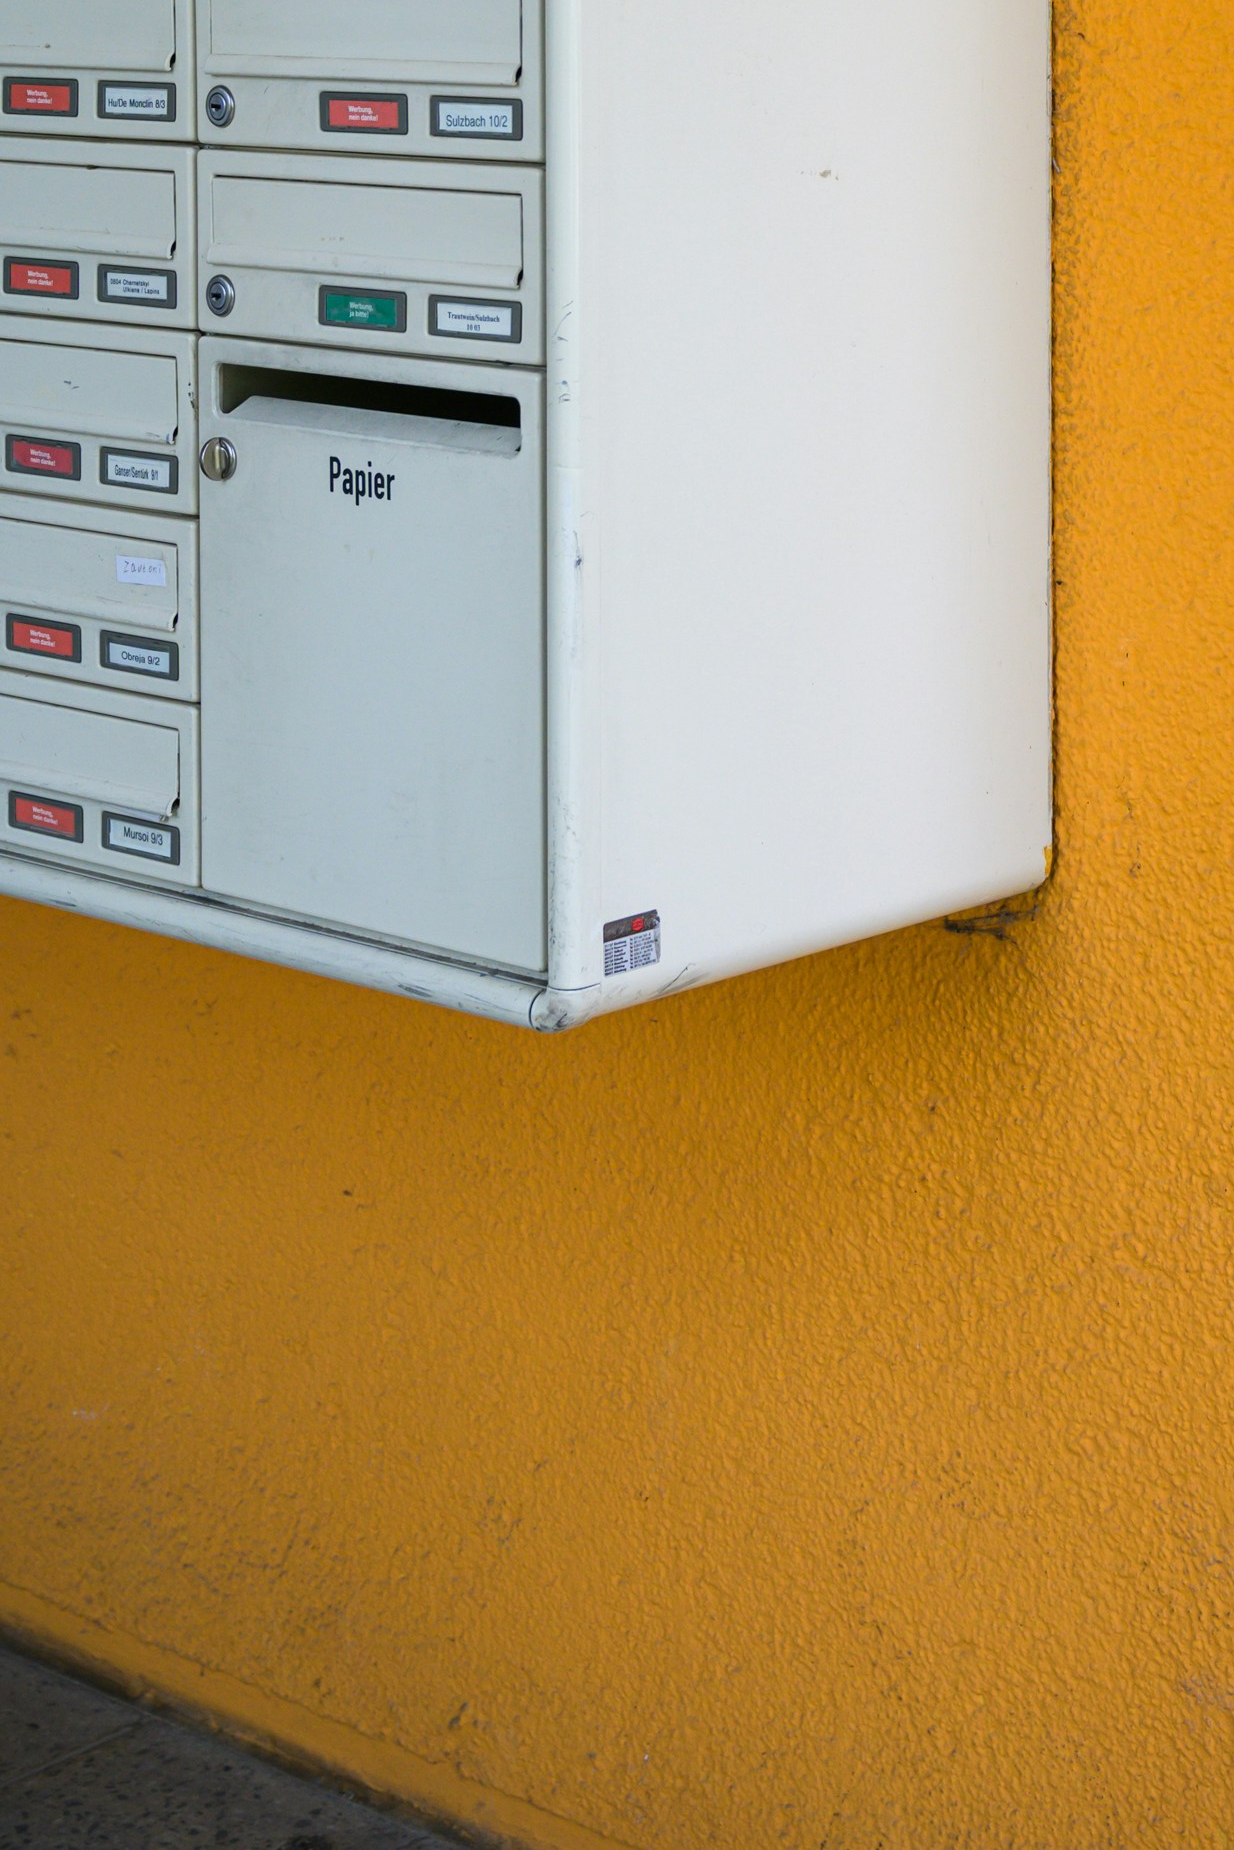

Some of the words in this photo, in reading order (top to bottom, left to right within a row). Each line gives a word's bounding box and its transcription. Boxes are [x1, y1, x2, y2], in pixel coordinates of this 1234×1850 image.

[27, 89, 48, 98] Werbung,
[37, 97, 53, 105] danke!
[108, 99, 127, 108] Hu/De
[129, 99, 153, 108] Monclin
[155, 100, 166, 109] 8/3
[348, 105, 373, 115] Werbung,
[360, 114, 379, 122] danke!
[446, 114, 486, 128] Sulzbach
[489, 116, 508, 128] 10/2
[28, 270, 49, 280] Werbung,
[38, 279, 54, 287] danke!
[349, 301, 374, 312] Werbung,
[30, 448, 52, 459] Werbung,
[329, 455, 396, 507] Papier
[30, 629, 51, 640] Werbung,
[121, 650, 146, 664] Obreja
[147, 655, 161, 666] 9/2
[32, 805, 54, 818] Werbung,
[123, 826, 149, 842] Mursoi
[150, 832, 164, 846] 9/3
